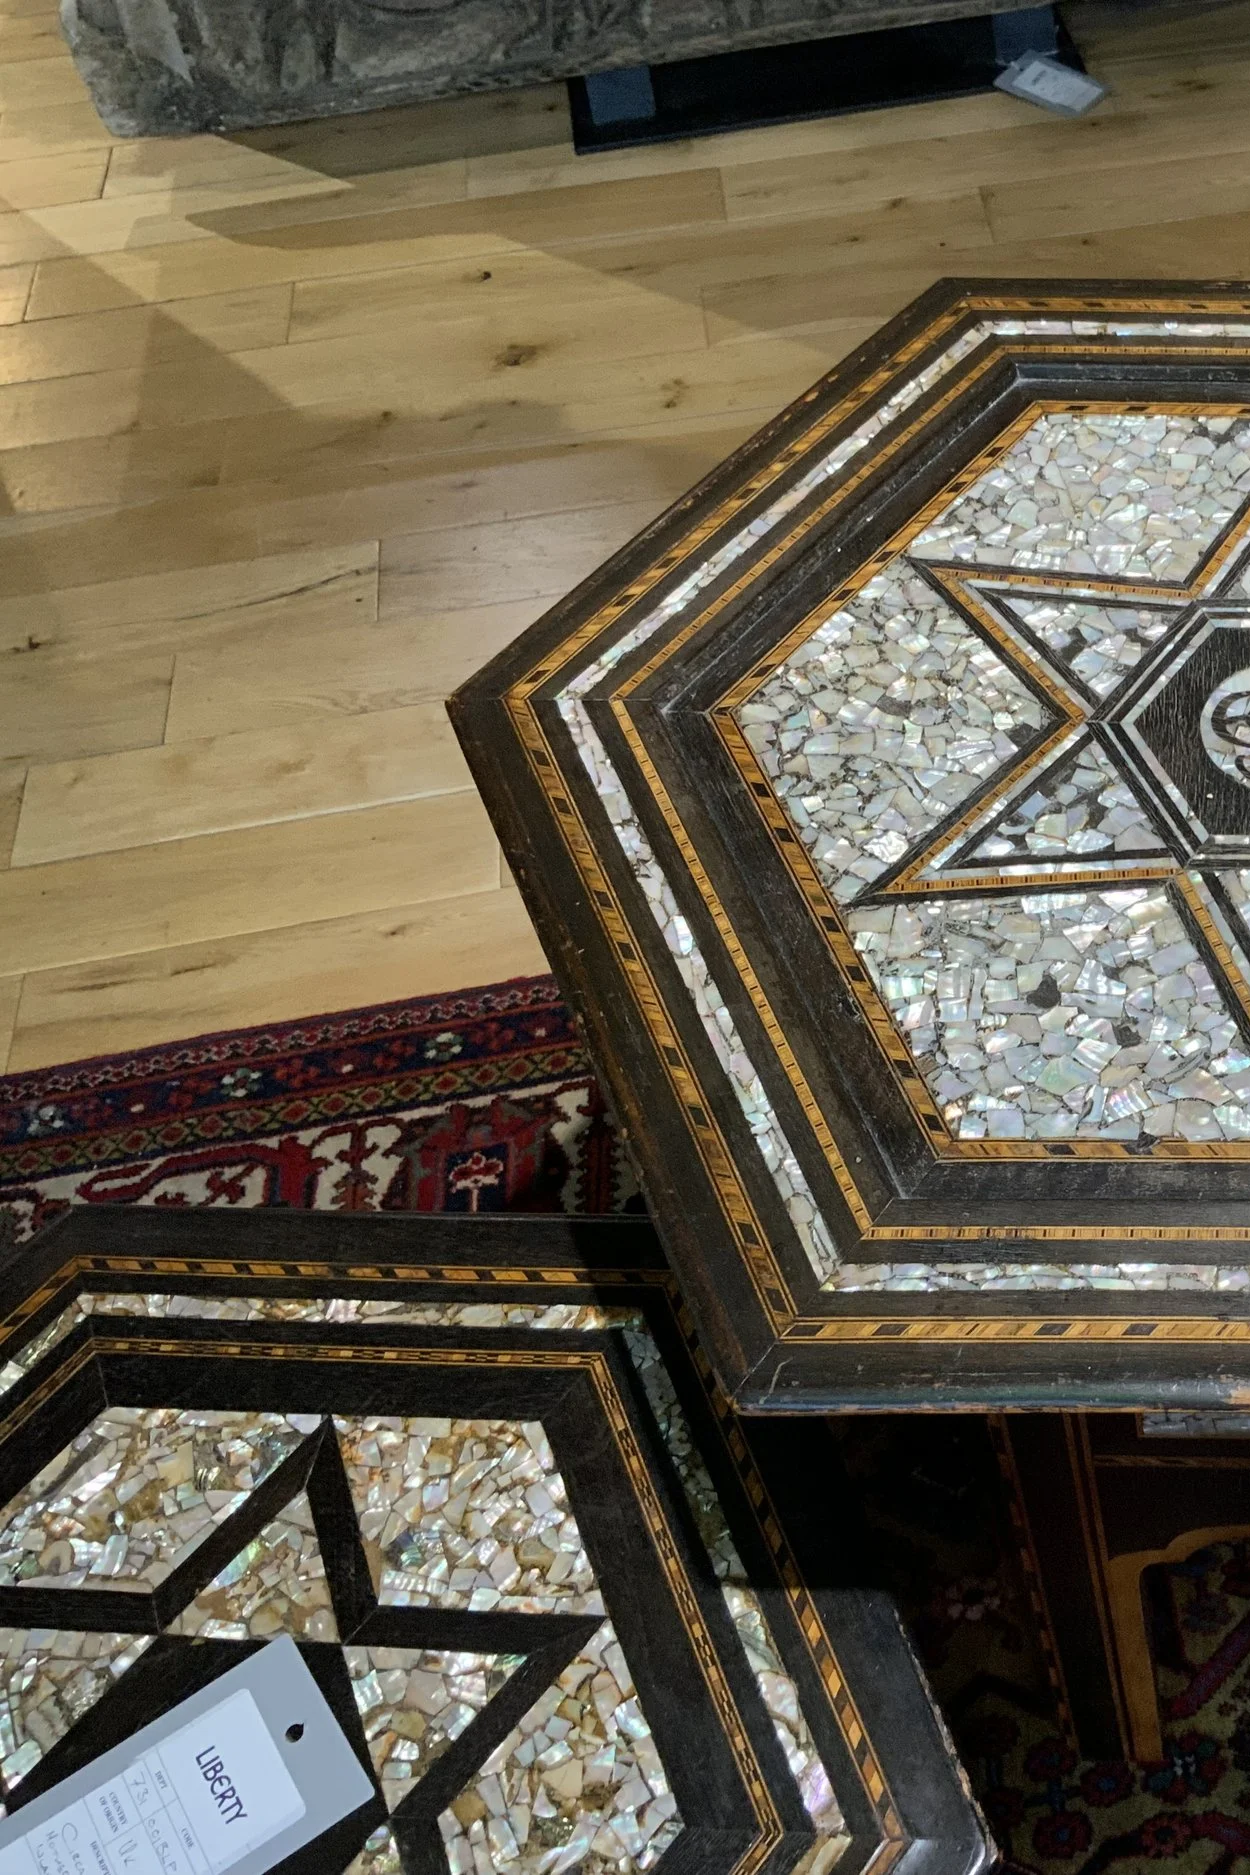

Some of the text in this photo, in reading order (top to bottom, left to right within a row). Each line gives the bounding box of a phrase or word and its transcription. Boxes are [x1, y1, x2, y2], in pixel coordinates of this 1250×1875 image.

[154, 1770, 168, 1790] DEPT
[195, 1745, 248, 1825] LIBERTY
[103, 1806, 119, 1834] ORIGIN
[109, 1792, 128, 1826] COUNTRY
[180, 1828, 195, 1850] CODE
